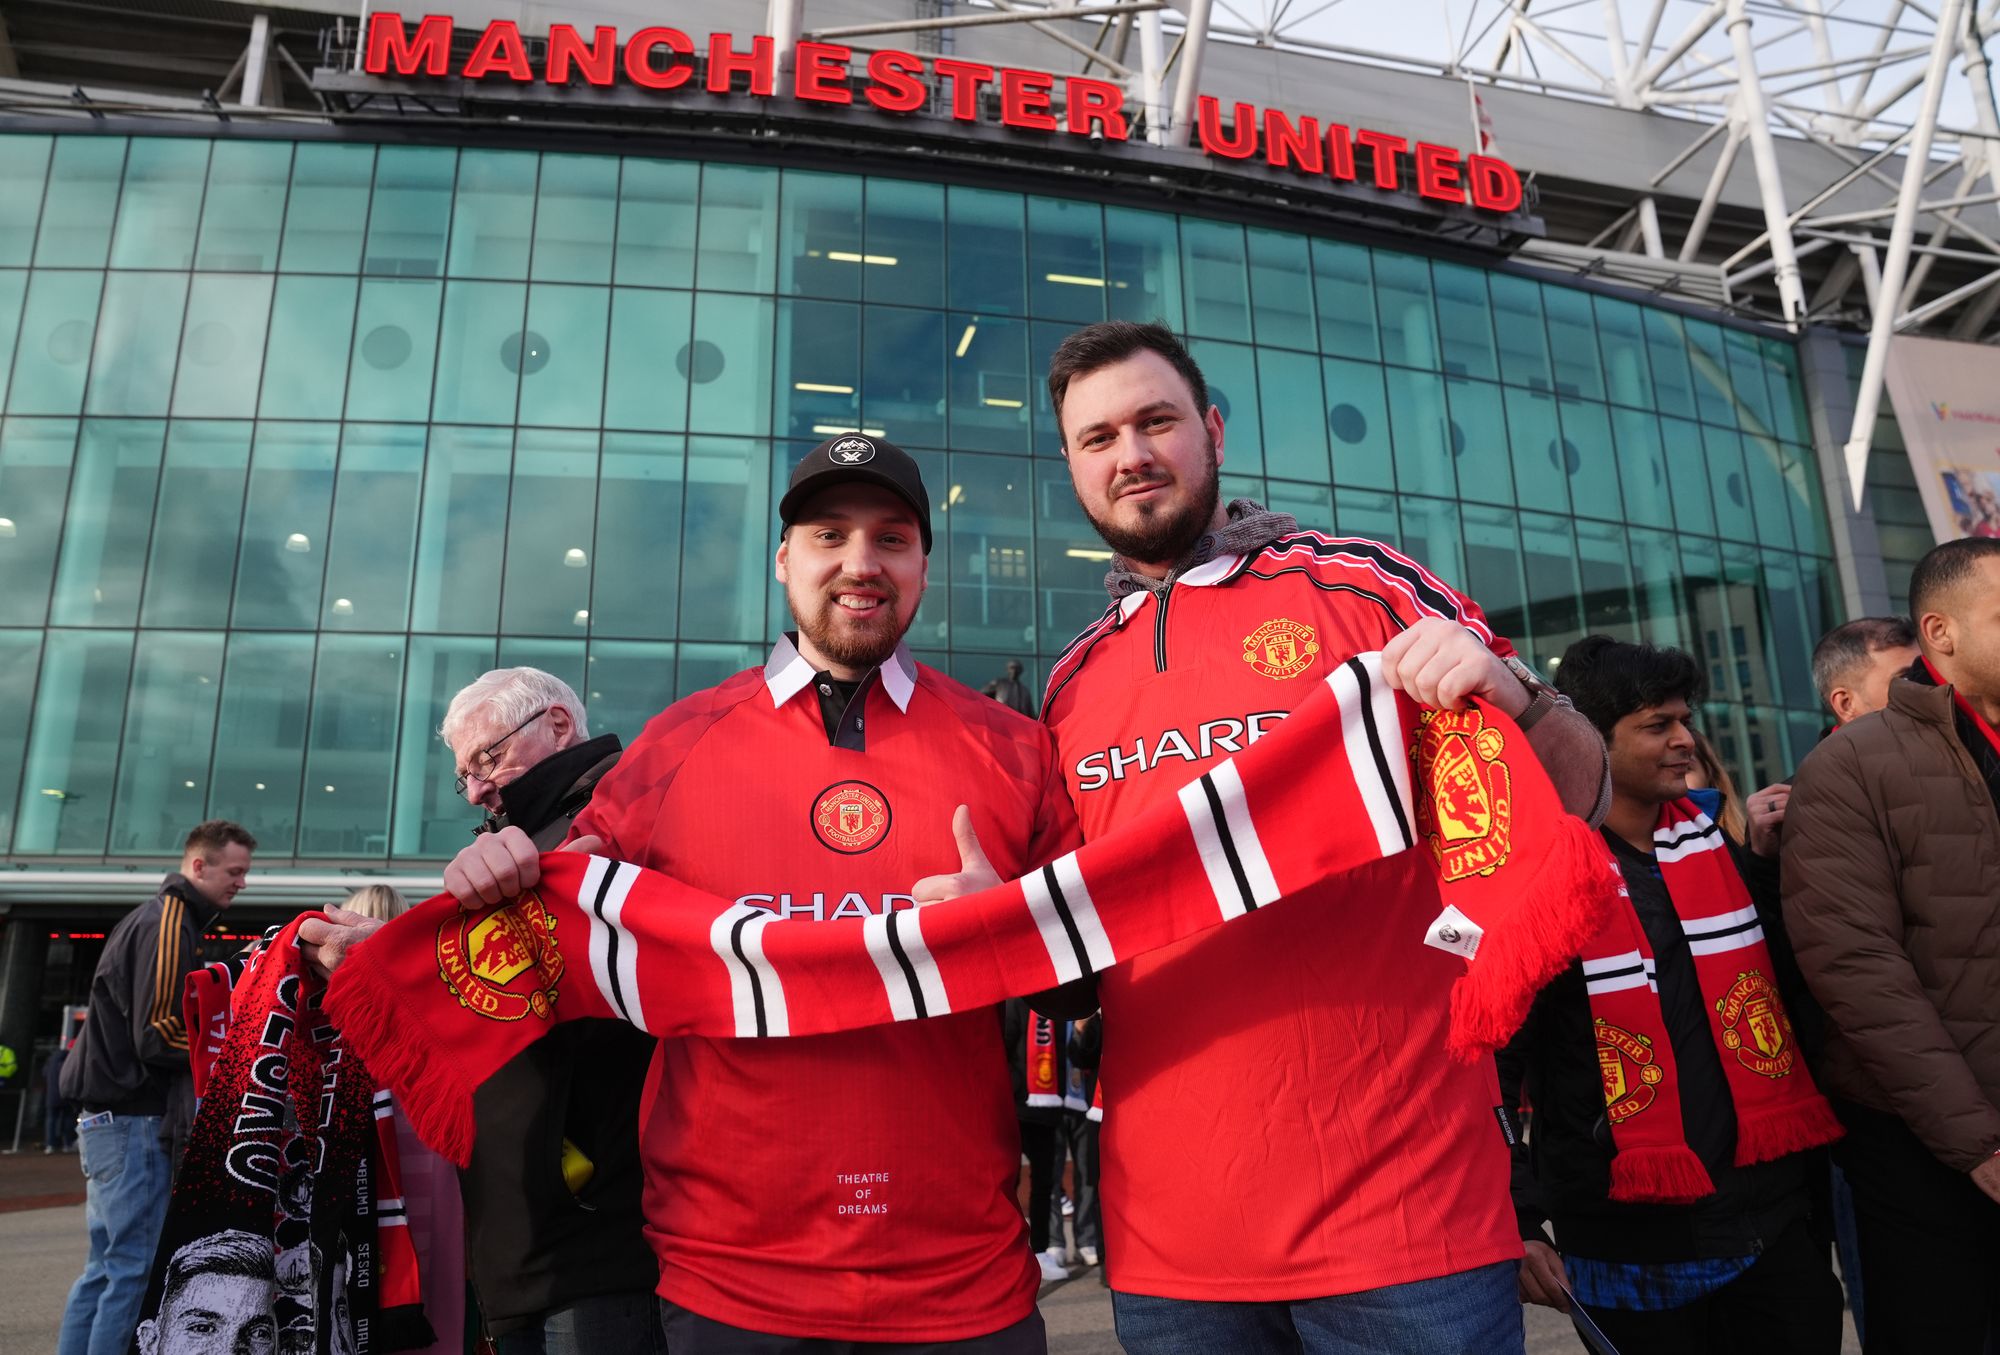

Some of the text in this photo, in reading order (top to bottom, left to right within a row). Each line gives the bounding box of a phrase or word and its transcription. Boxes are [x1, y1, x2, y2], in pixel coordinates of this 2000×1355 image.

[364, 11, 1523, 213] MANCHESTER UNITED
[1249, 622, 1310, 649] MANCHESTER
[1263, 661, 1306, 676] UNITED
[824, 792, 878, 813] MANCHESTER UNITED
[828, 827, 875, 842] FOOTBALL CLUB
[1449, 798, 1509, 875] UNITED
[440, 939, 499, 1013] UNITED
[1755, 1050, 1792, 1071] UNITED
[836, 1172, 889, 1184] THEATRE
[855, 1189, 871, 1199] OF
[838, 1204, 888, 1214] DREAMS
[358, 1242, 370, 1288] SESKO
